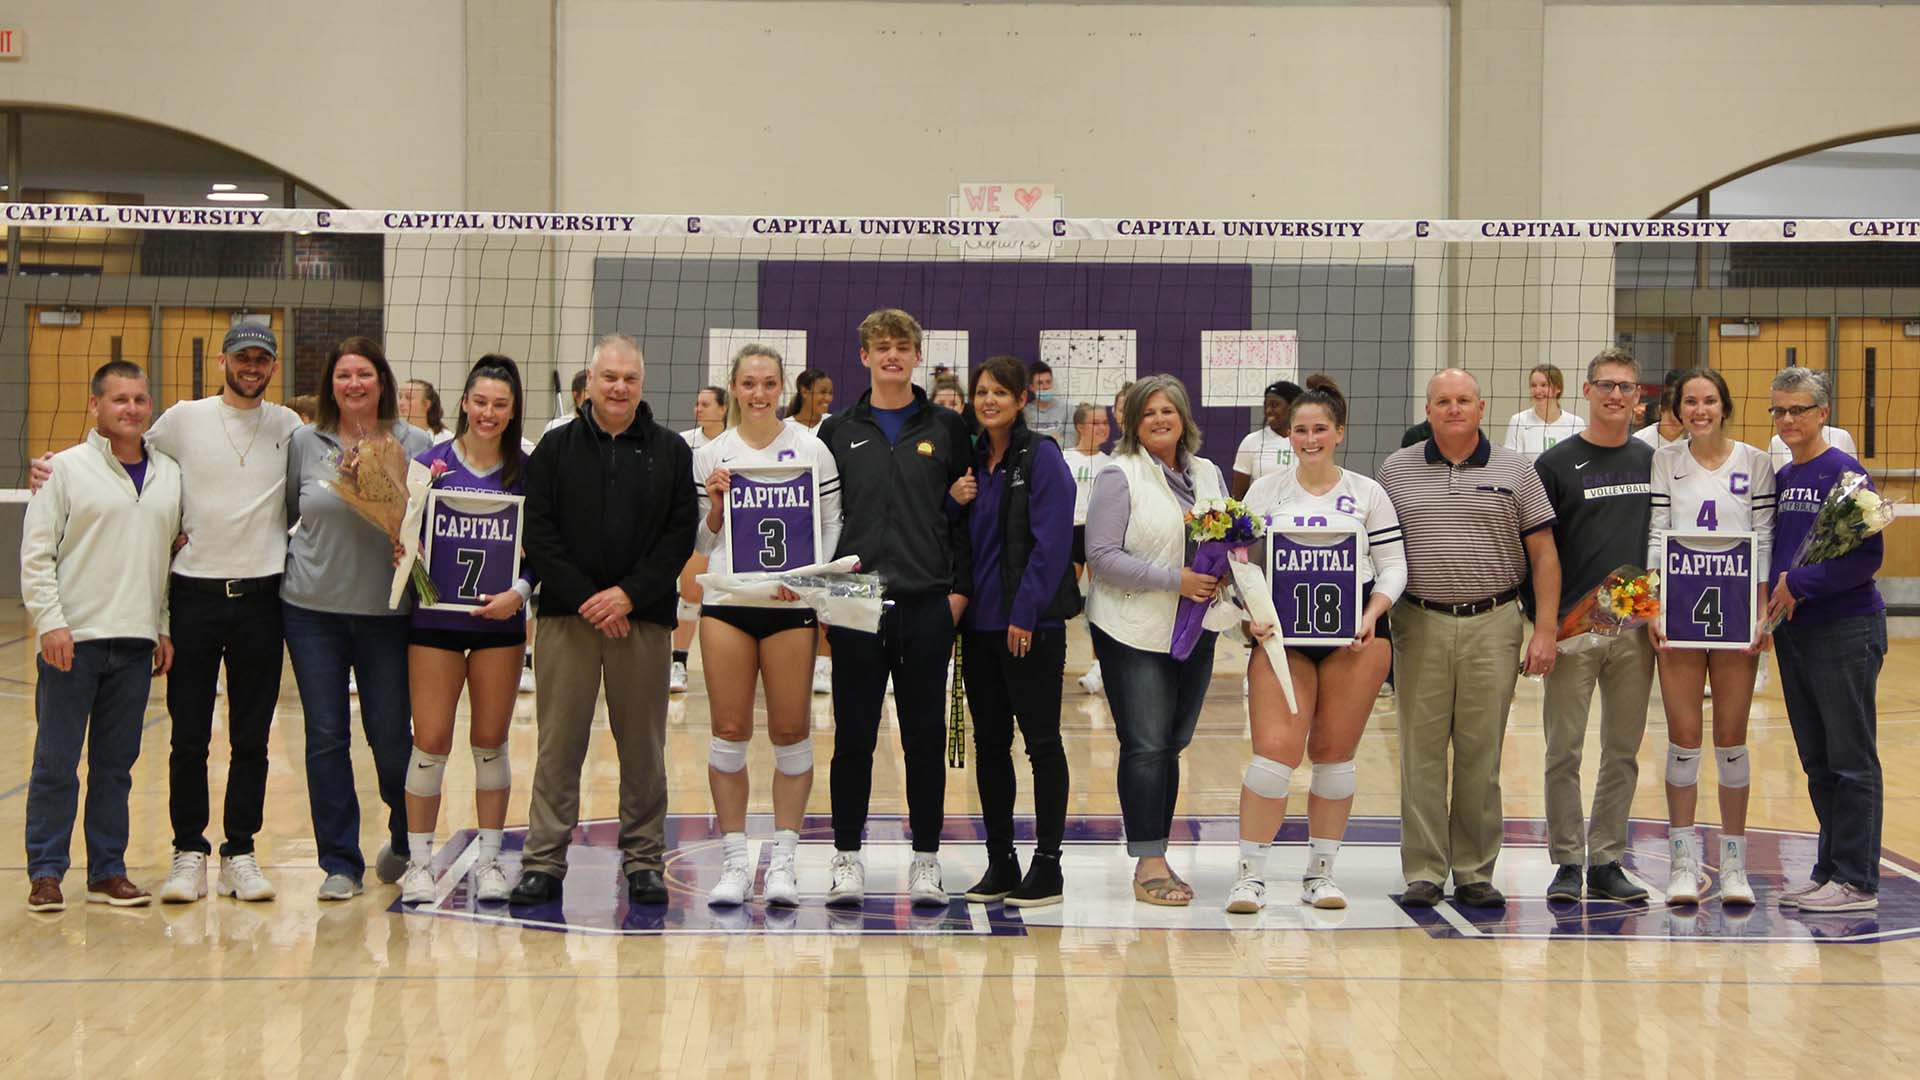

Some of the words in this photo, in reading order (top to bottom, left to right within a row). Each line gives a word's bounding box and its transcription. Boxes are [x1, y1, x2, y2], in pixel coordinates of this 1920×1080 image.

[964, 186, 1001, 212] WE
[5, 205, 110, 222] CAPITAL
[118, 207, 264, 225] UNIVERSITY
[383, 213, 485, 229] CAPITAL
[492, 214, 635, 232] UNIVERSITY
[752, 218, 852, 235] CAPITAL
[859, 219, 1001, 236] UNIVERSITY
[1052, 219, 1066, 237] C
[1116, 219, 1216, 236] CAPITAL
[1222, 220, 1364, 237] UNIVERSITY
[1415, 220, 1430, 238] C
[1481, 221, 1581, 238] CAPITAL
[1588, 221, 1731, 238] UNIVERSITY
[1849, 220, 1920, 237] CAPIT
[1276, 448, 1292, 465] 15
[1590, 484, 1649, 497] VOLLEYBALL
[1729, 472, 1750, 496] C
[731, 485, 810, 508] CAPITAL
[1335, 495, 1357, 515] C
[1696, 499, 1719, 531] 4
[435, 514, 513, 541] CAPITAL
[758, 518, 787, 568] 3
[1275, 549, 1354, 572] CAPITAL
[1669, 552, 1749, 577] CAPITAL
[457, 547, 486, 599] 7
[1293, 582, 1342, 634] 18
[1692, 586, 1723, 637] 4
